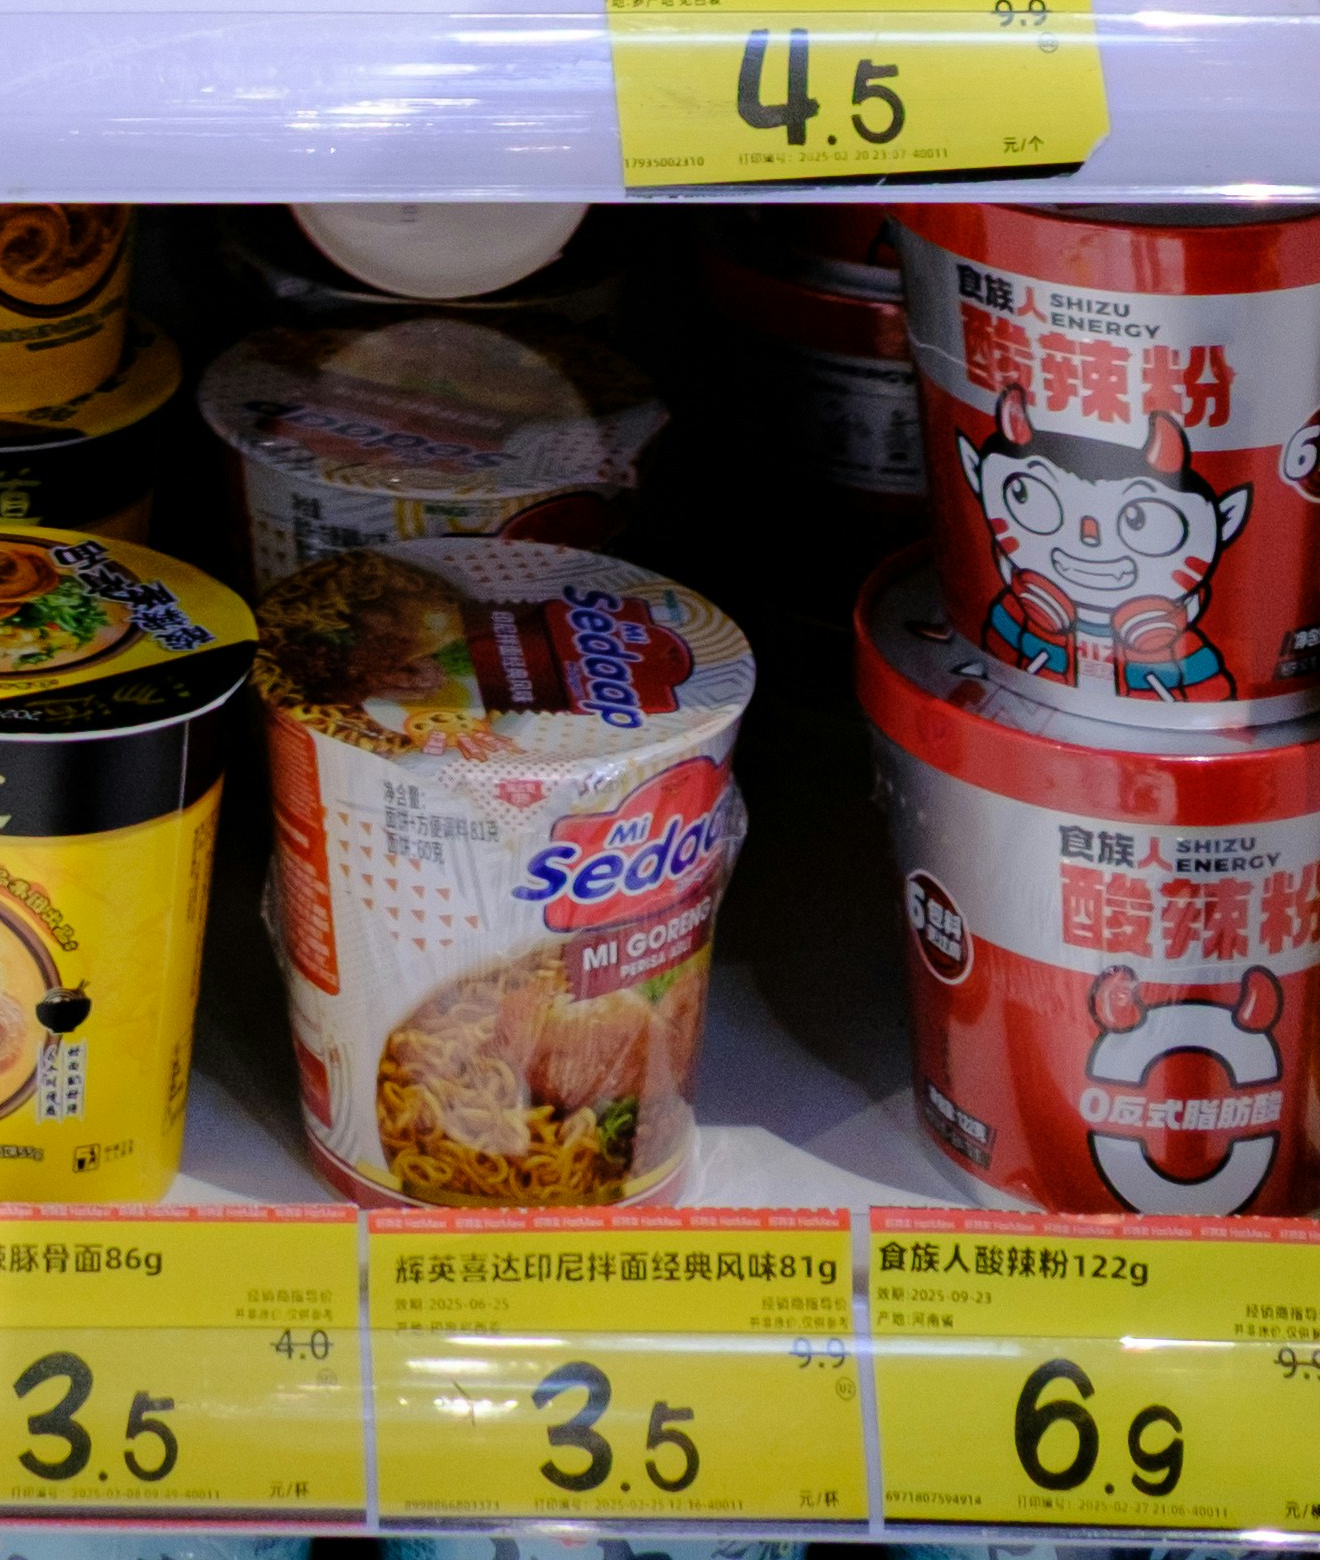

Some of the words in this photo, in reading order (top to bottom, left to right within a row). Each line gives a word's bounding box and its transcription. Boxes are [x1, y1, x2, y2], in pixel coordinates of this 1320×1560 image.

[737, 27, 906, 146] 4.5
[1050, 293, 1130, 318] SHIZU
[1051, 314, 1162, 338] ENERGY
[563, 585, 644, 728] Sedaap
[1059, 825, 1173, 872] 食族人
[1176, 837, 1257, 853] SHIZU
[1177, 852, 1281, 873] ENERGY
[395, 1252, 838, 1284] 辉英喜达印尼拌面经典风味81g
[878, 1241, 1150, 1286] 食族人酸辣粉122g
[271, 1329, 334, 1361] 4.0
[790, 1336, 847, 1370] 9.9
[13, 1350, 179, 1483] 3.5
[531, 1360, 700, 1493] 3.5
[1014, 1358, 1185, 1497] 6.9
